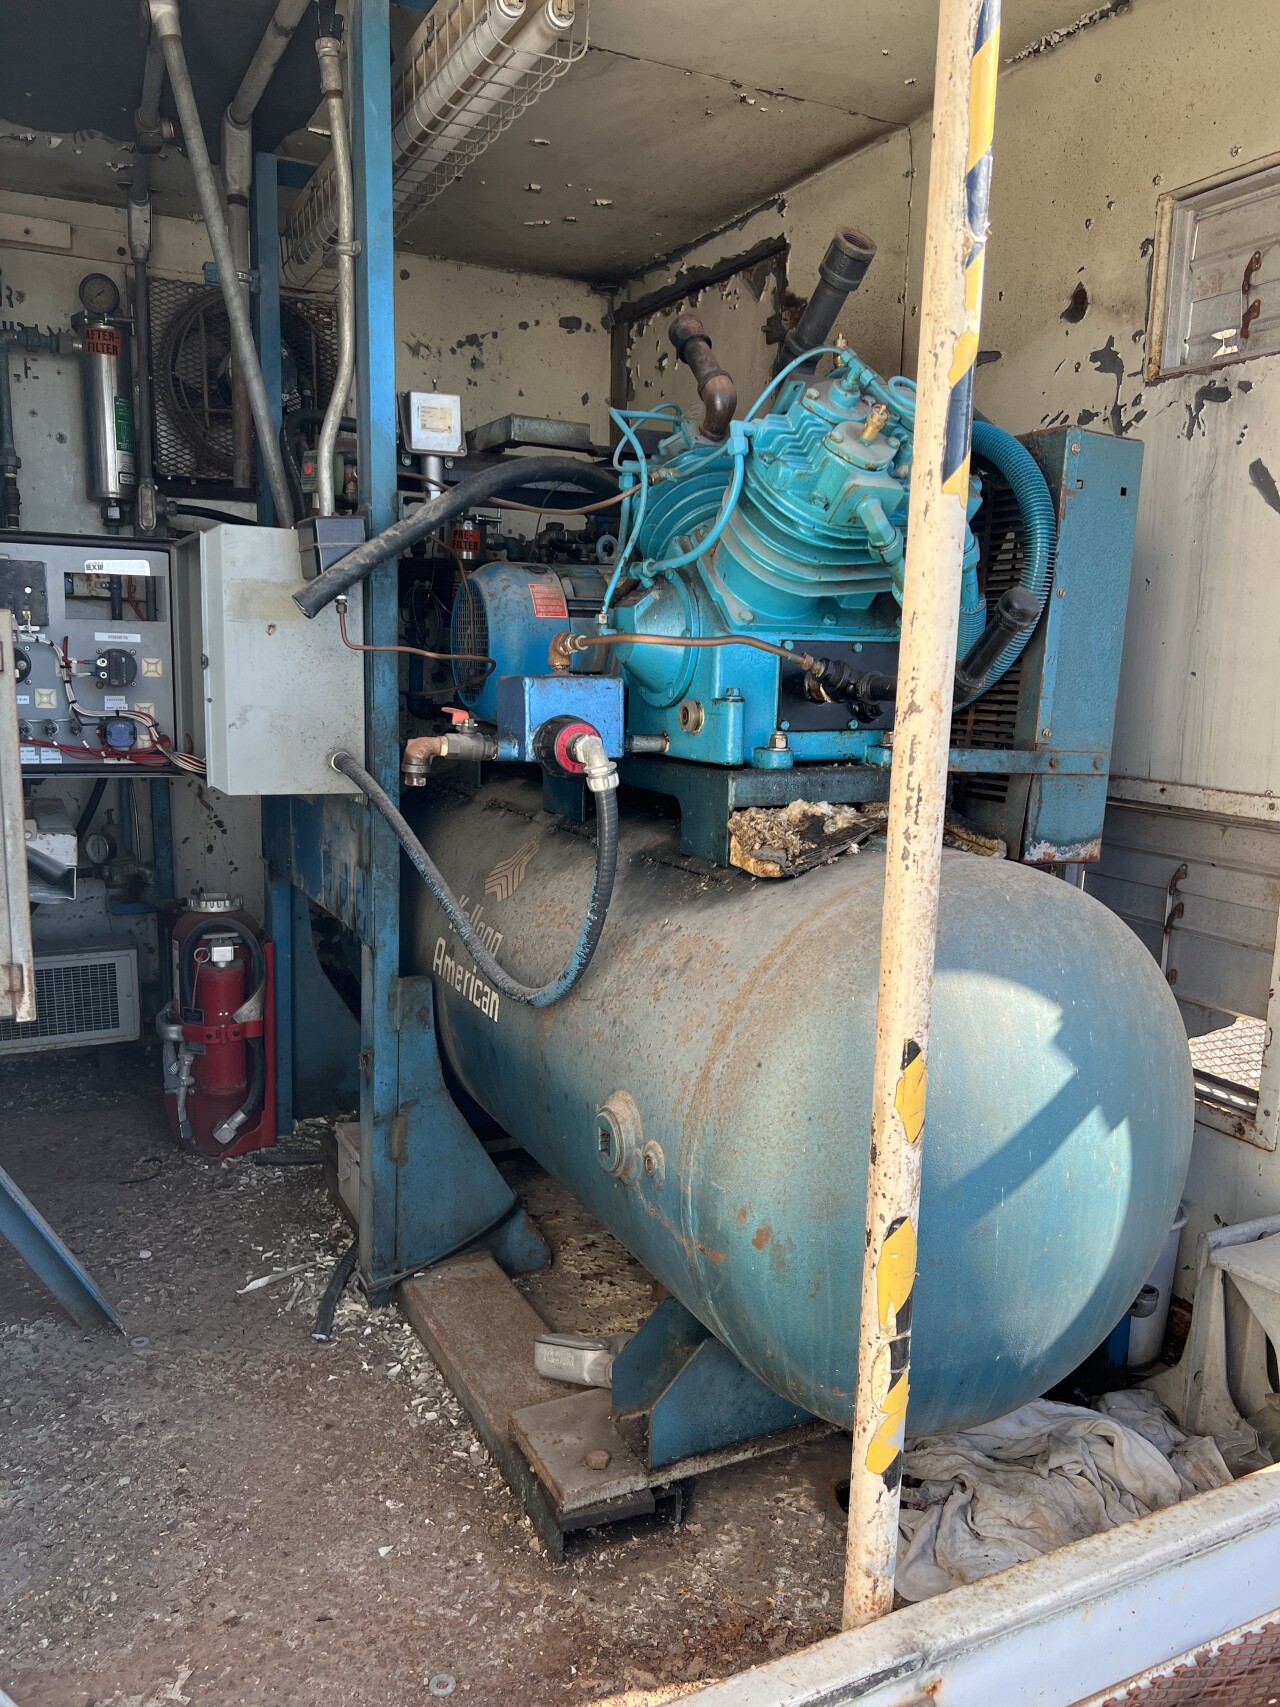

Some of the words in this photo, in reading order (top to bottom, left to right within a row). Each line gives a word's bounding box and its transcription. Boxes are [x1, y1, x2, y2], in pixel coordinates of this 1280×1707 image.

[85, 329, 120, 342] AFTER-
[87, 342, 119, 355] FILTER
[453, 529, 475, 540] PRE-
[452, 540, 479, 551] FILTER
[432, 936, 500, 1023] American
